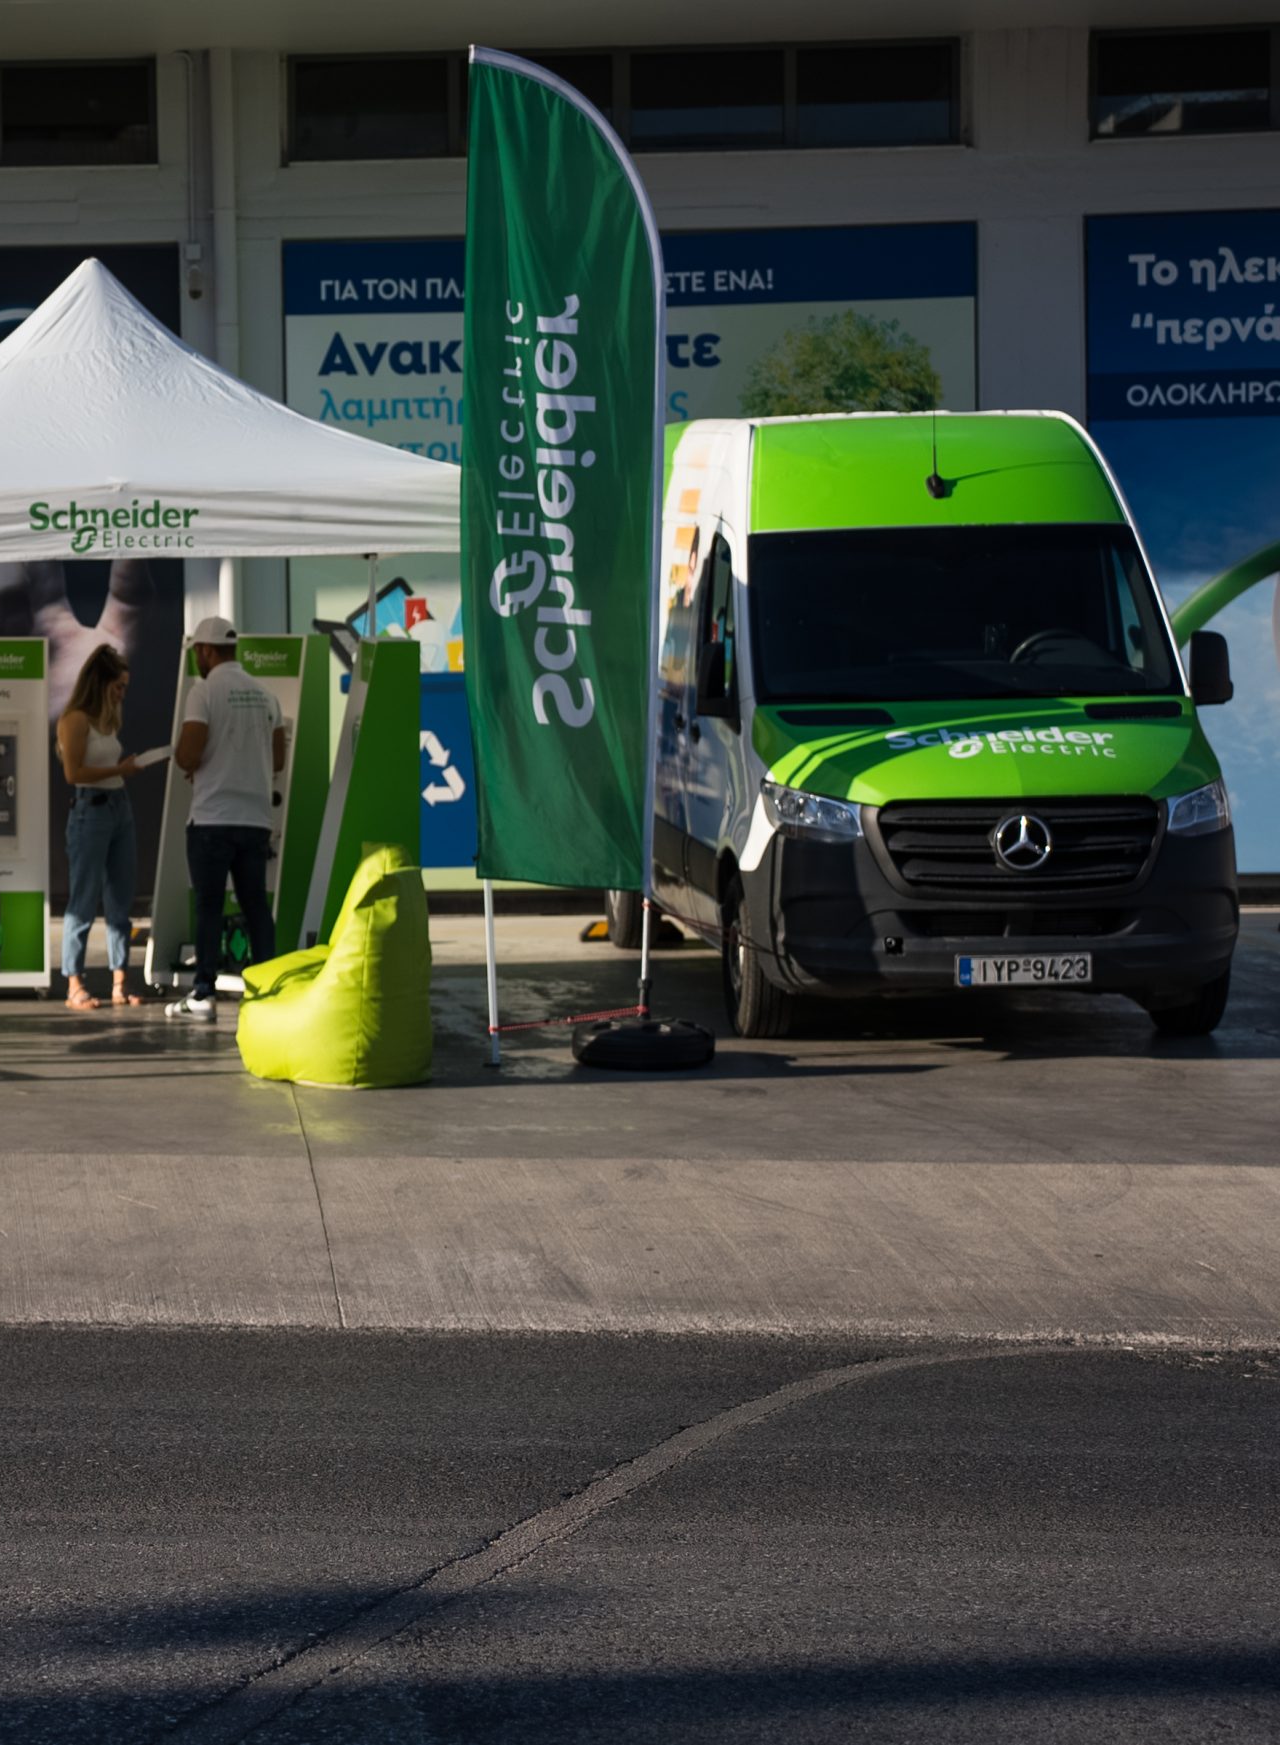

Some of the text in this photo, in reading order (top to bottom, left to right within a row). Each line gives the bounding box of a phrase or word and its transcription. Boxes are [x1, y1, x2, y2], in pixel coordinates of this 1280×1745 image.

[1128, 246, 1280, 292] Το ηλεκ
[320, 279, 359, 301] ΓΙΑ
[362, 278, 417, 300] ΤΟΝ
[425, 277, 464, 299] ΠΛ
[713, 268, 774, 292] ΕΝΑ!
[1126, 380, 1280, 407] ΟΛΟΚΛΗΡΩ
[29, 499, 199, 531] Schneider
[102, 531, 195, 548] Electric
[884, 726, 1114, 749] Schneider
[990, 741, 1117, 758] Electric
